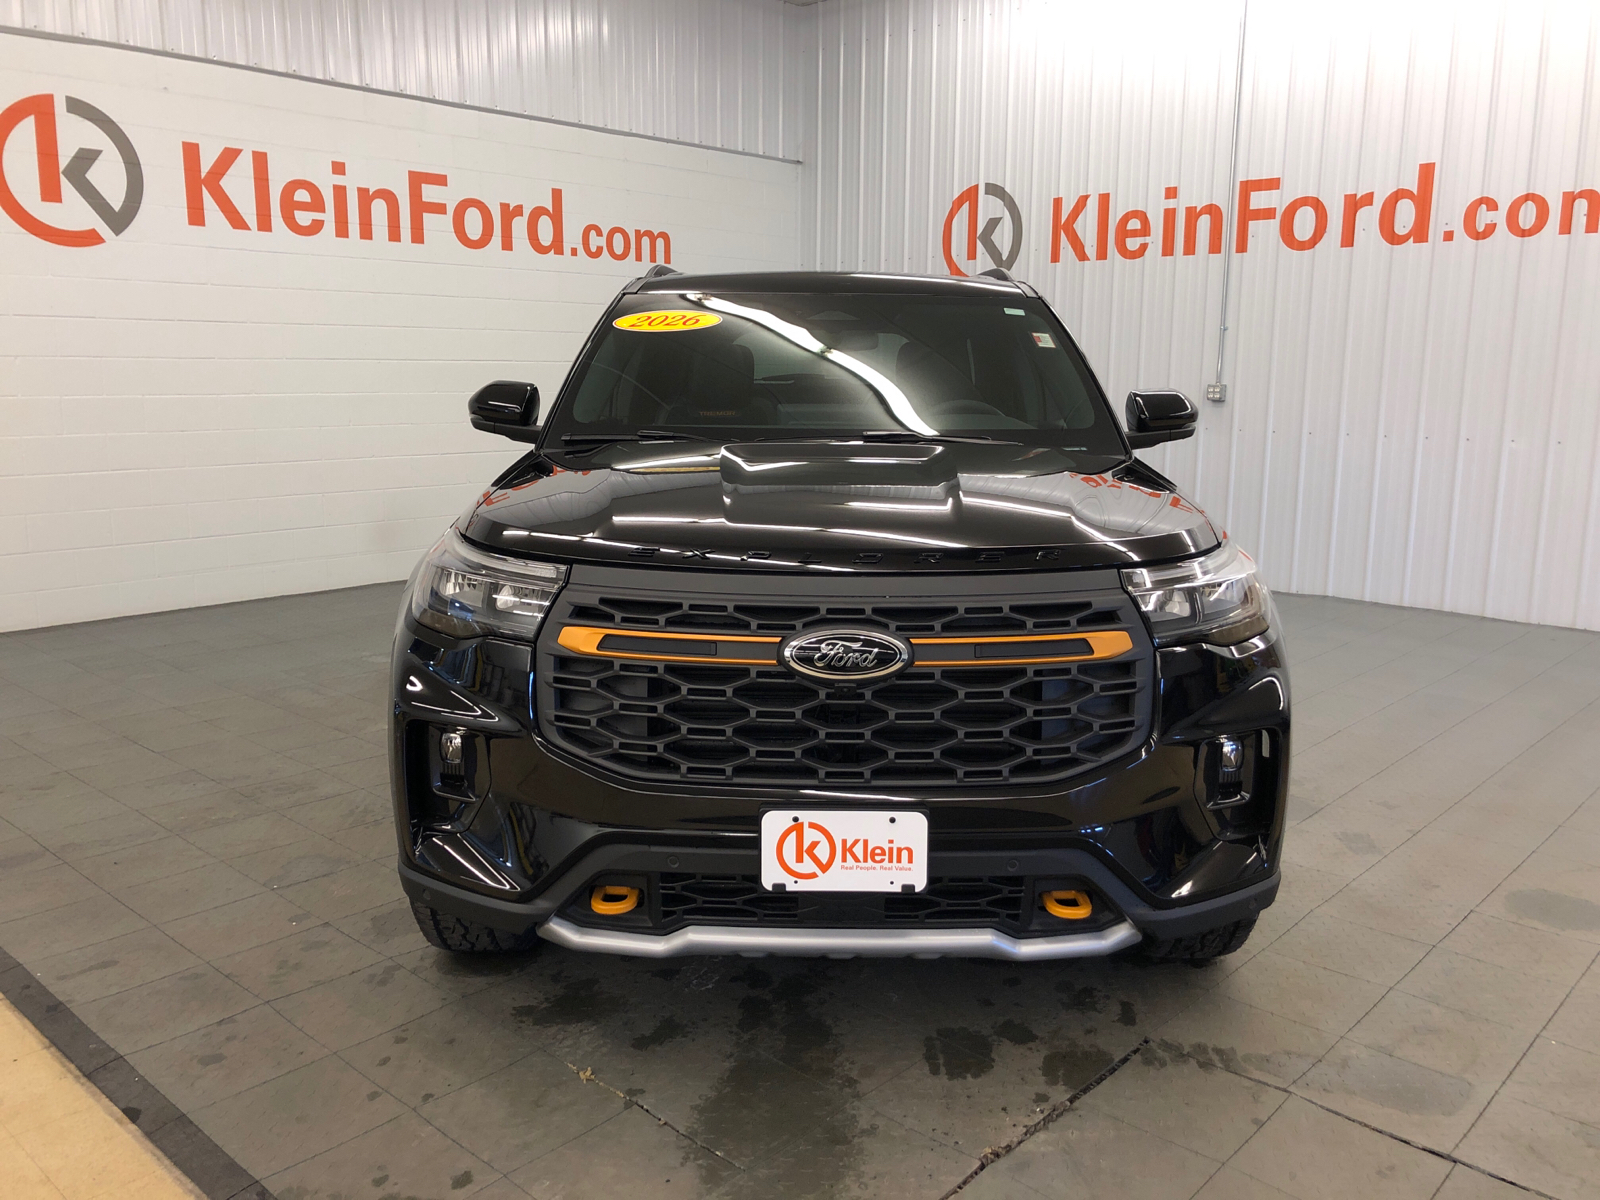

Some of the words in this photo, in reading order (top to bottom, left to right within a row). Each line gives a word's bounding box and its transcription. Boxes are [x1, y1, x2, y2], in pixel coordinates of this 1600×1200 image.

[181, 141, 672, 265] KleinFord.com
[627, 314, 708, 328] 2026
[627, 547, 1061, 564] EXPLORER
[813, 640, 880, 667] Ford
[840, 838, 914, 864] Klein
[855, 864, 878, 872] People.
